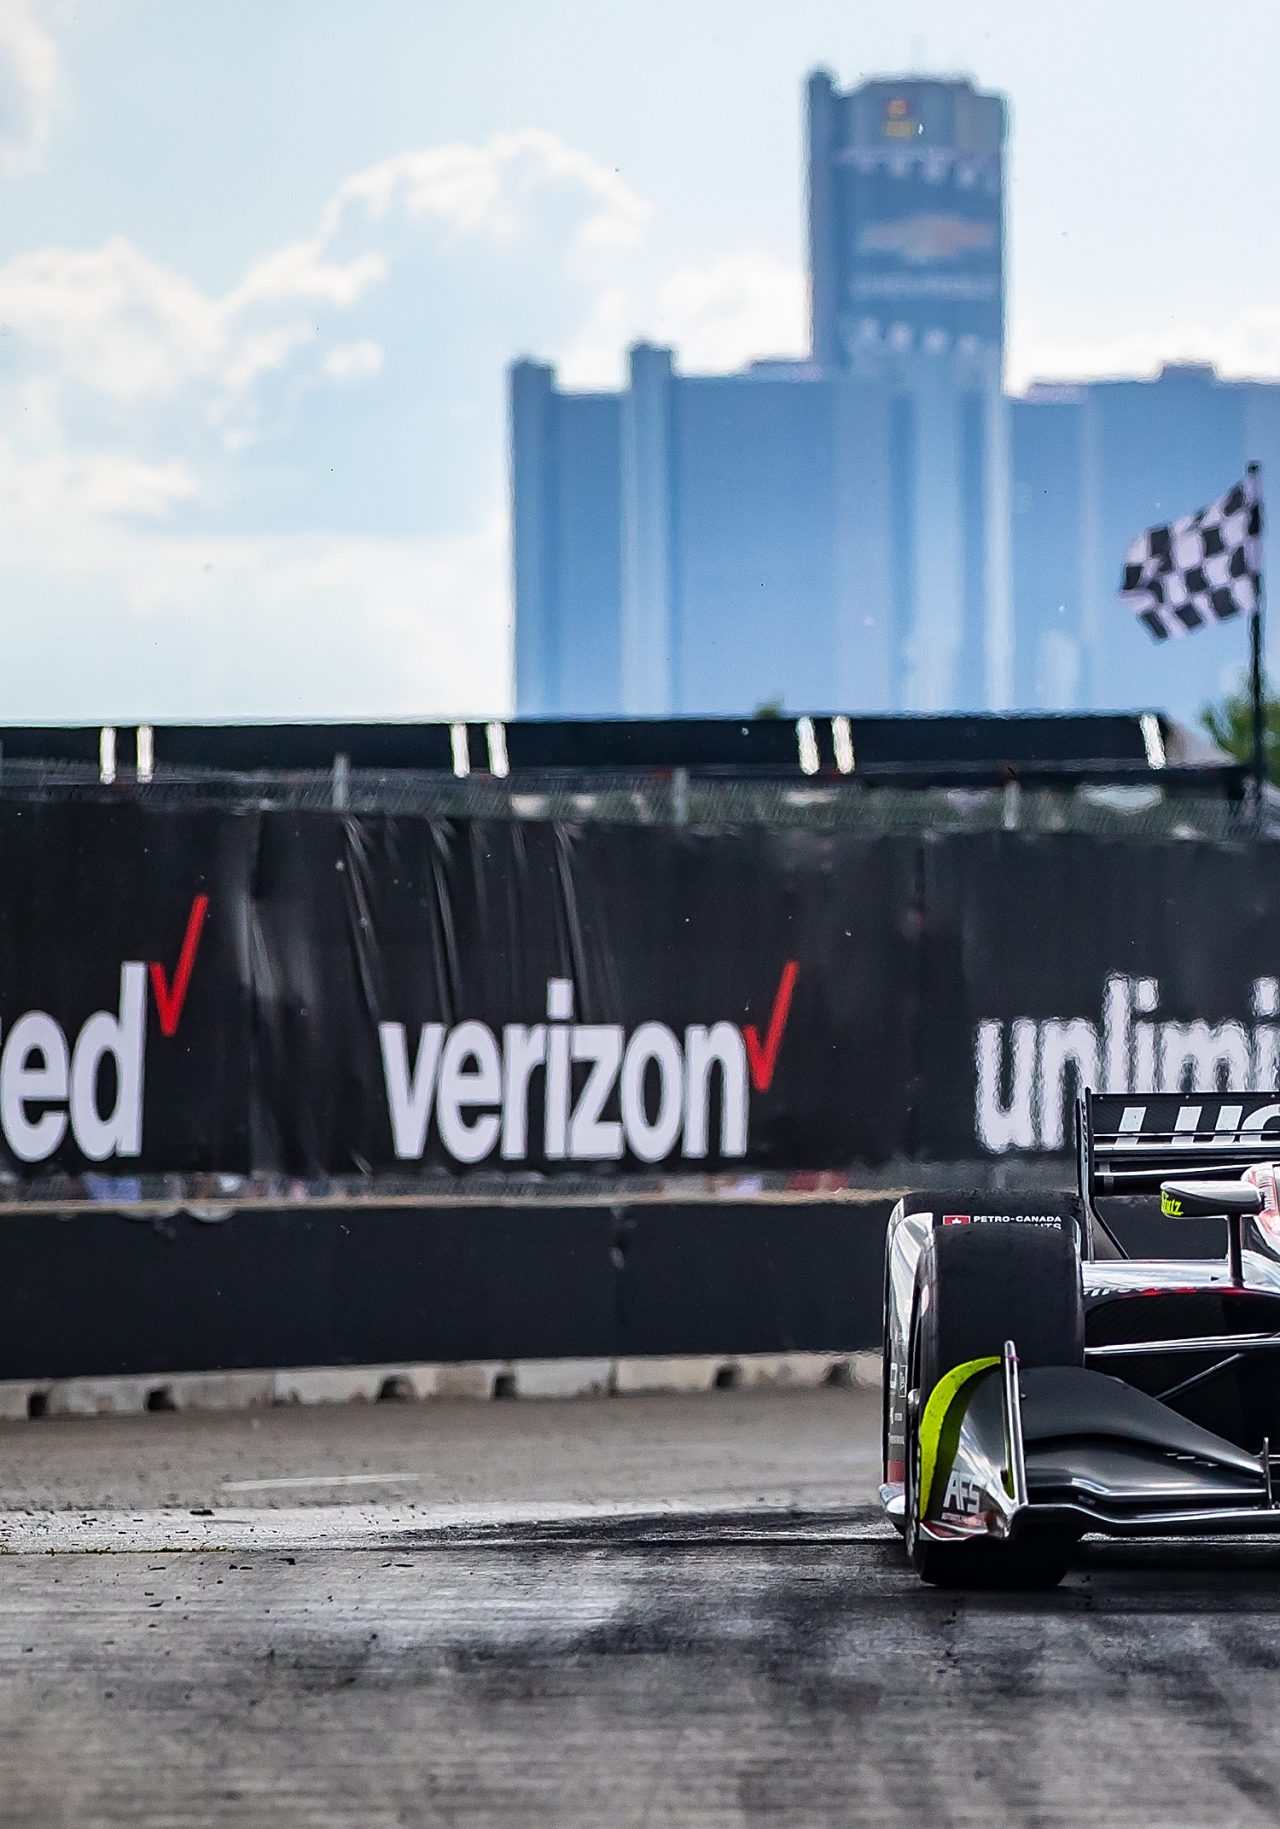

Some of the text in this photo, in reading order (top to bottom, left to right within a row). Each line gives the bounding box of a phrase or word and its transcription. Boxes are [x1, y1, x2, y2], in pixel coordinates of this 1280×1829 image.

[377, 977, 750, 1163] verizon
[973, 1215, 1062, 1223] PETRO-CANADA
[942, 1470, 981, 1514] AFS
